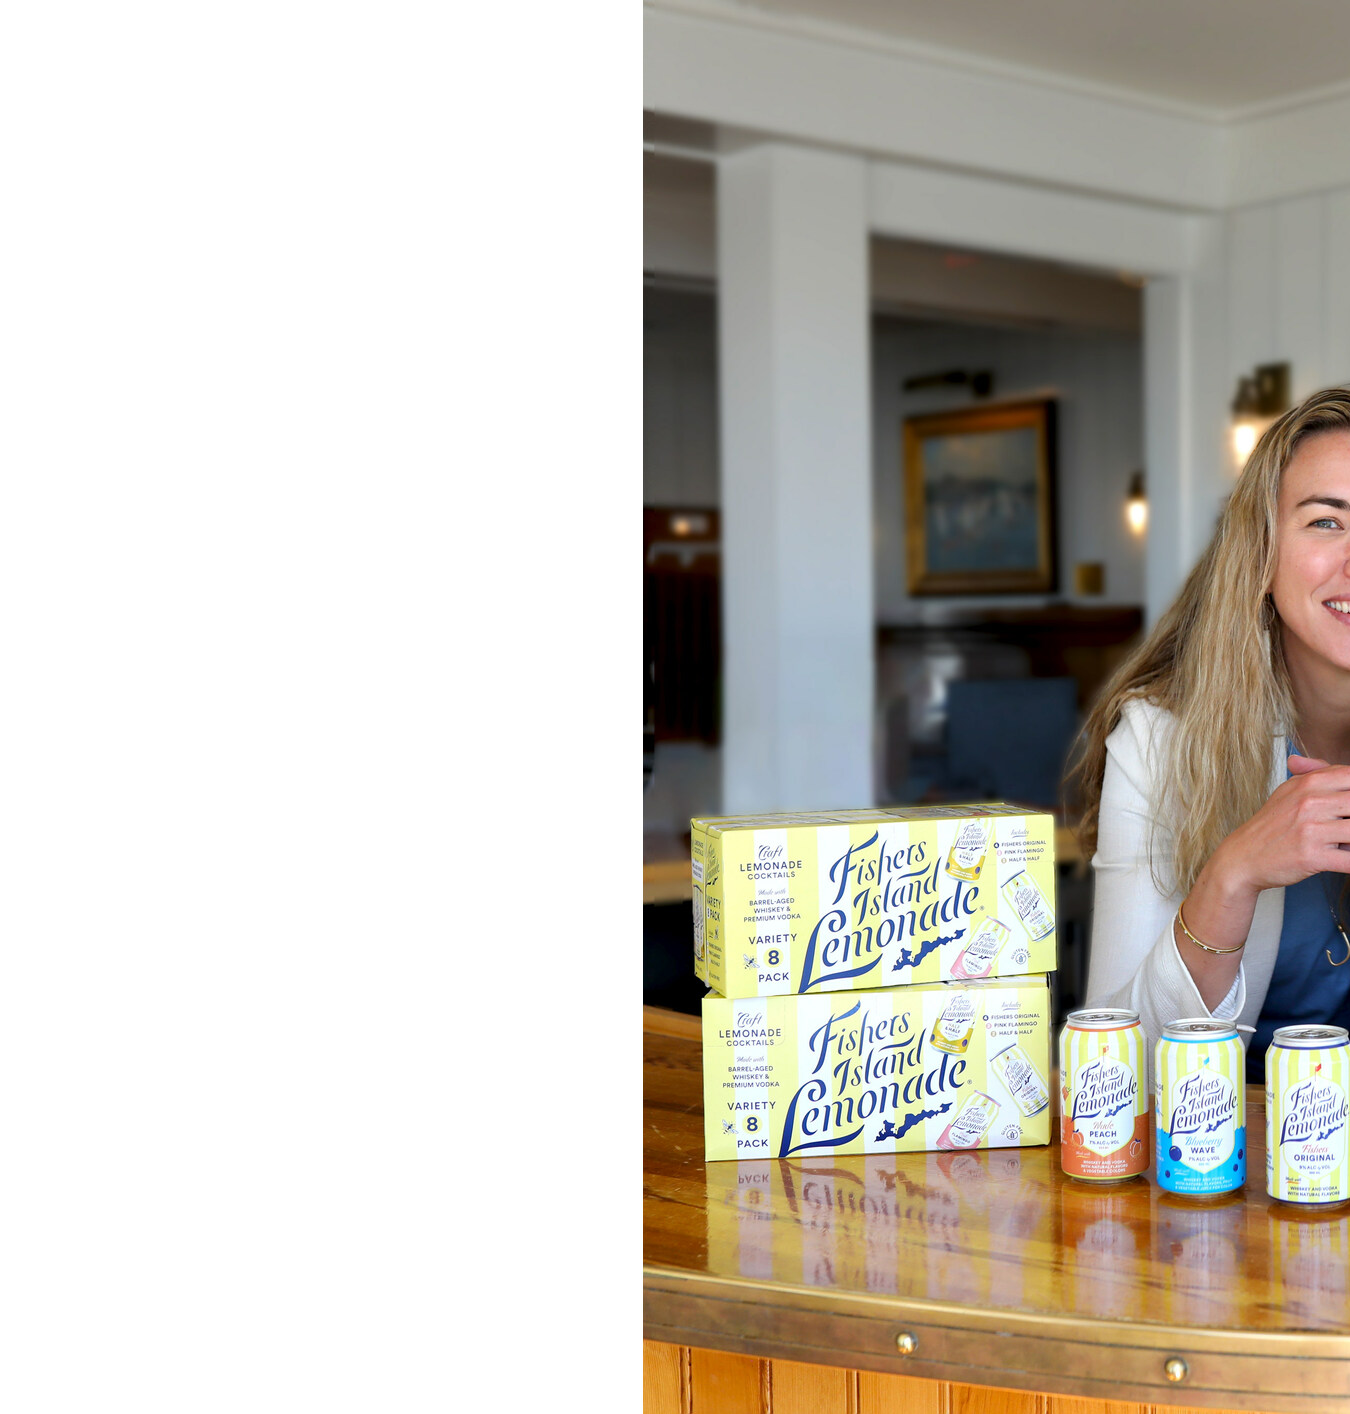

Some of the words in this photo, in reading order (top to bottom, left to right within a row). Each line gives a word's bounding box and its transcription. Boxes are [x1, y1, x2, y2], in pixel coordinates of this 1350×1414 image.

[758, 844, 784, 861] Craft
[740, 860, 802, 872] LEMONADE
[829, 830, 926, 905] Fishers
[747, 871, 796, 880] COCKTAILS
[853, 856, 942, 926] Island
[749, 897, 795, 906] BARREL-AGED
[753, 906, 785, 914] WHISKEY
[743, 915, 776, 923] PREMIUM
[777, 913, 801, 921] VODKA
[748, 933, 798, 945] VARIETY
[768, 950, 780, 965] 8
[758, 972, 790, 982] PACK
[737, 1012, 763, 1029] Craft
[719, 1028, 782, 1039] LEMONADE
[809, 999, 911, 1075] Fishers
[726, 1039, 775, 1047] COCKTAILS
[833, 1027, 927, 1097] Island
[728, 1065, 774, 1073] BARREL-AGED
[1081, 1061, 1120, 1089] Fishers
[1089, 1070, 1125, 1098] Island
[1179, 1074, 1220, 1104] Fishers
[1071, 1074, 1137, 1122] Lemonade
[1188, 1084, 1226, 1114] Island
[1290, 1081, 1332, 1111] Fishers
[727, 1101, 776, 1111] VARIETY
[1168, 1087, 1237, 1138] Lemonade
[1299, 1092, 1337, 1121] Island
[746, 1116, 759, 1132] 8
[1279, 1095, 1349, 1147] Lemonade
[1089, 1130, 1117, 1138] PEACH
[737, 1139, 769, 1148] PACK
[1185, 1136, 1223, 1147] Blueberry
[1190, 1146, 1216, 1154] WAVE
[1302, 1144, 1329, 1154] Fishers
[1294, 1154, 1336, 1162] ORIGINAL
